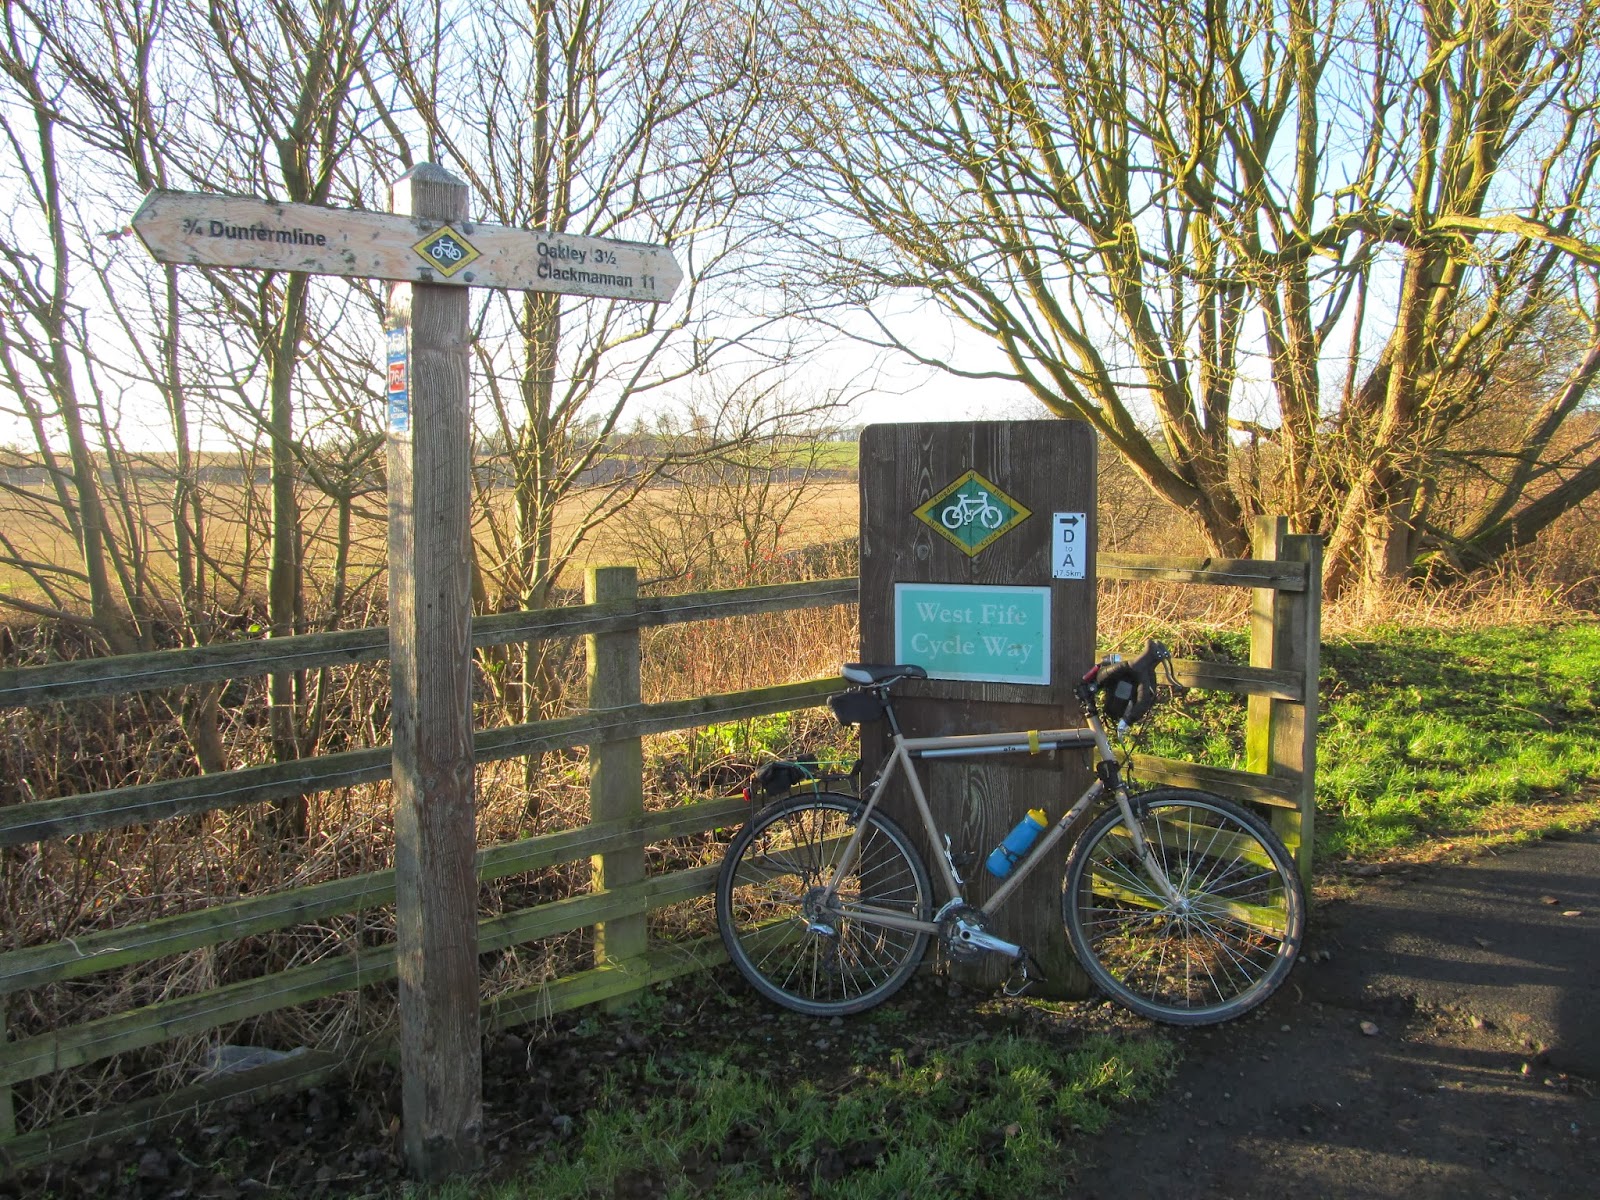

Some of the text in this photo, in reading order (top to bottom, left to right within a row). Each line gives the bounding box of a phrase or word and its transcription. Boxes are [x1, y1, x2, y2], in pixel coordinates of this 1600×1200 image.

[209, 220, 327, 247] Dunfermline
[536, 242, 587, 264] Oakley
[537, 263, 656, 290] Clackmannan 11
[1063, 529, 1075, 543] D
[1062, 554, 1075, 567] A
[1055, 569, 1082, 577] 17.5km
[916, 602, 1027, 626] West Fife
[911, 633, 1033, 664] Cycle Way
